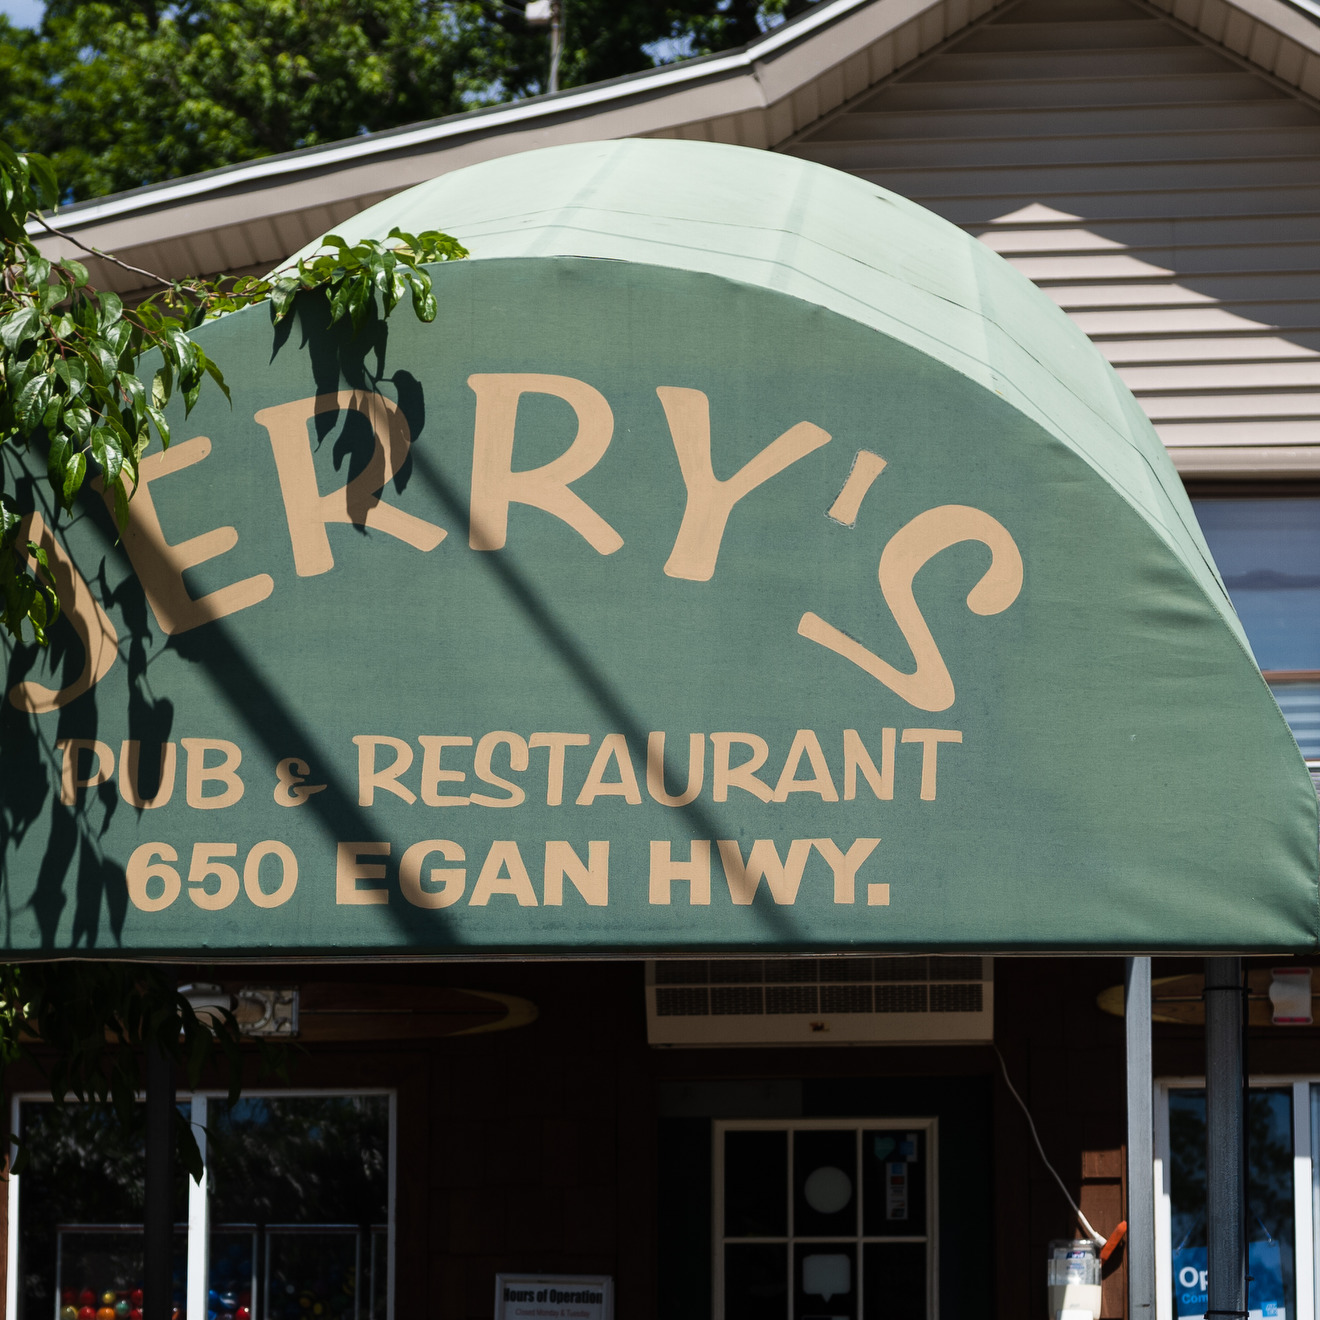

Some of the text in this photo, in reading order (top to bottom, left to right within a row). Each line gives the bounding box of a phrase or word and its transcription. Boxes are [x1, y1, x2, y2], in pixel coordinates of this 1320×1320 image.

[9, 373, 1024, 714] JERRY'S
[56, 729, 963, 810] PUB & RESTAURANT
[125, 838, 891, 913] 650 EGAN HWY.
[1179, 1266, 1208, 1291] Op
[503, 1287, 603, 1305] Hours of Operation
[1182, 1293, 1208, 1304] Com
[515, 1308, 536, 1317] Closed
[536, 1308, 560, 1319] Monday
[567, 1309, 591, 1319] Tuesday
